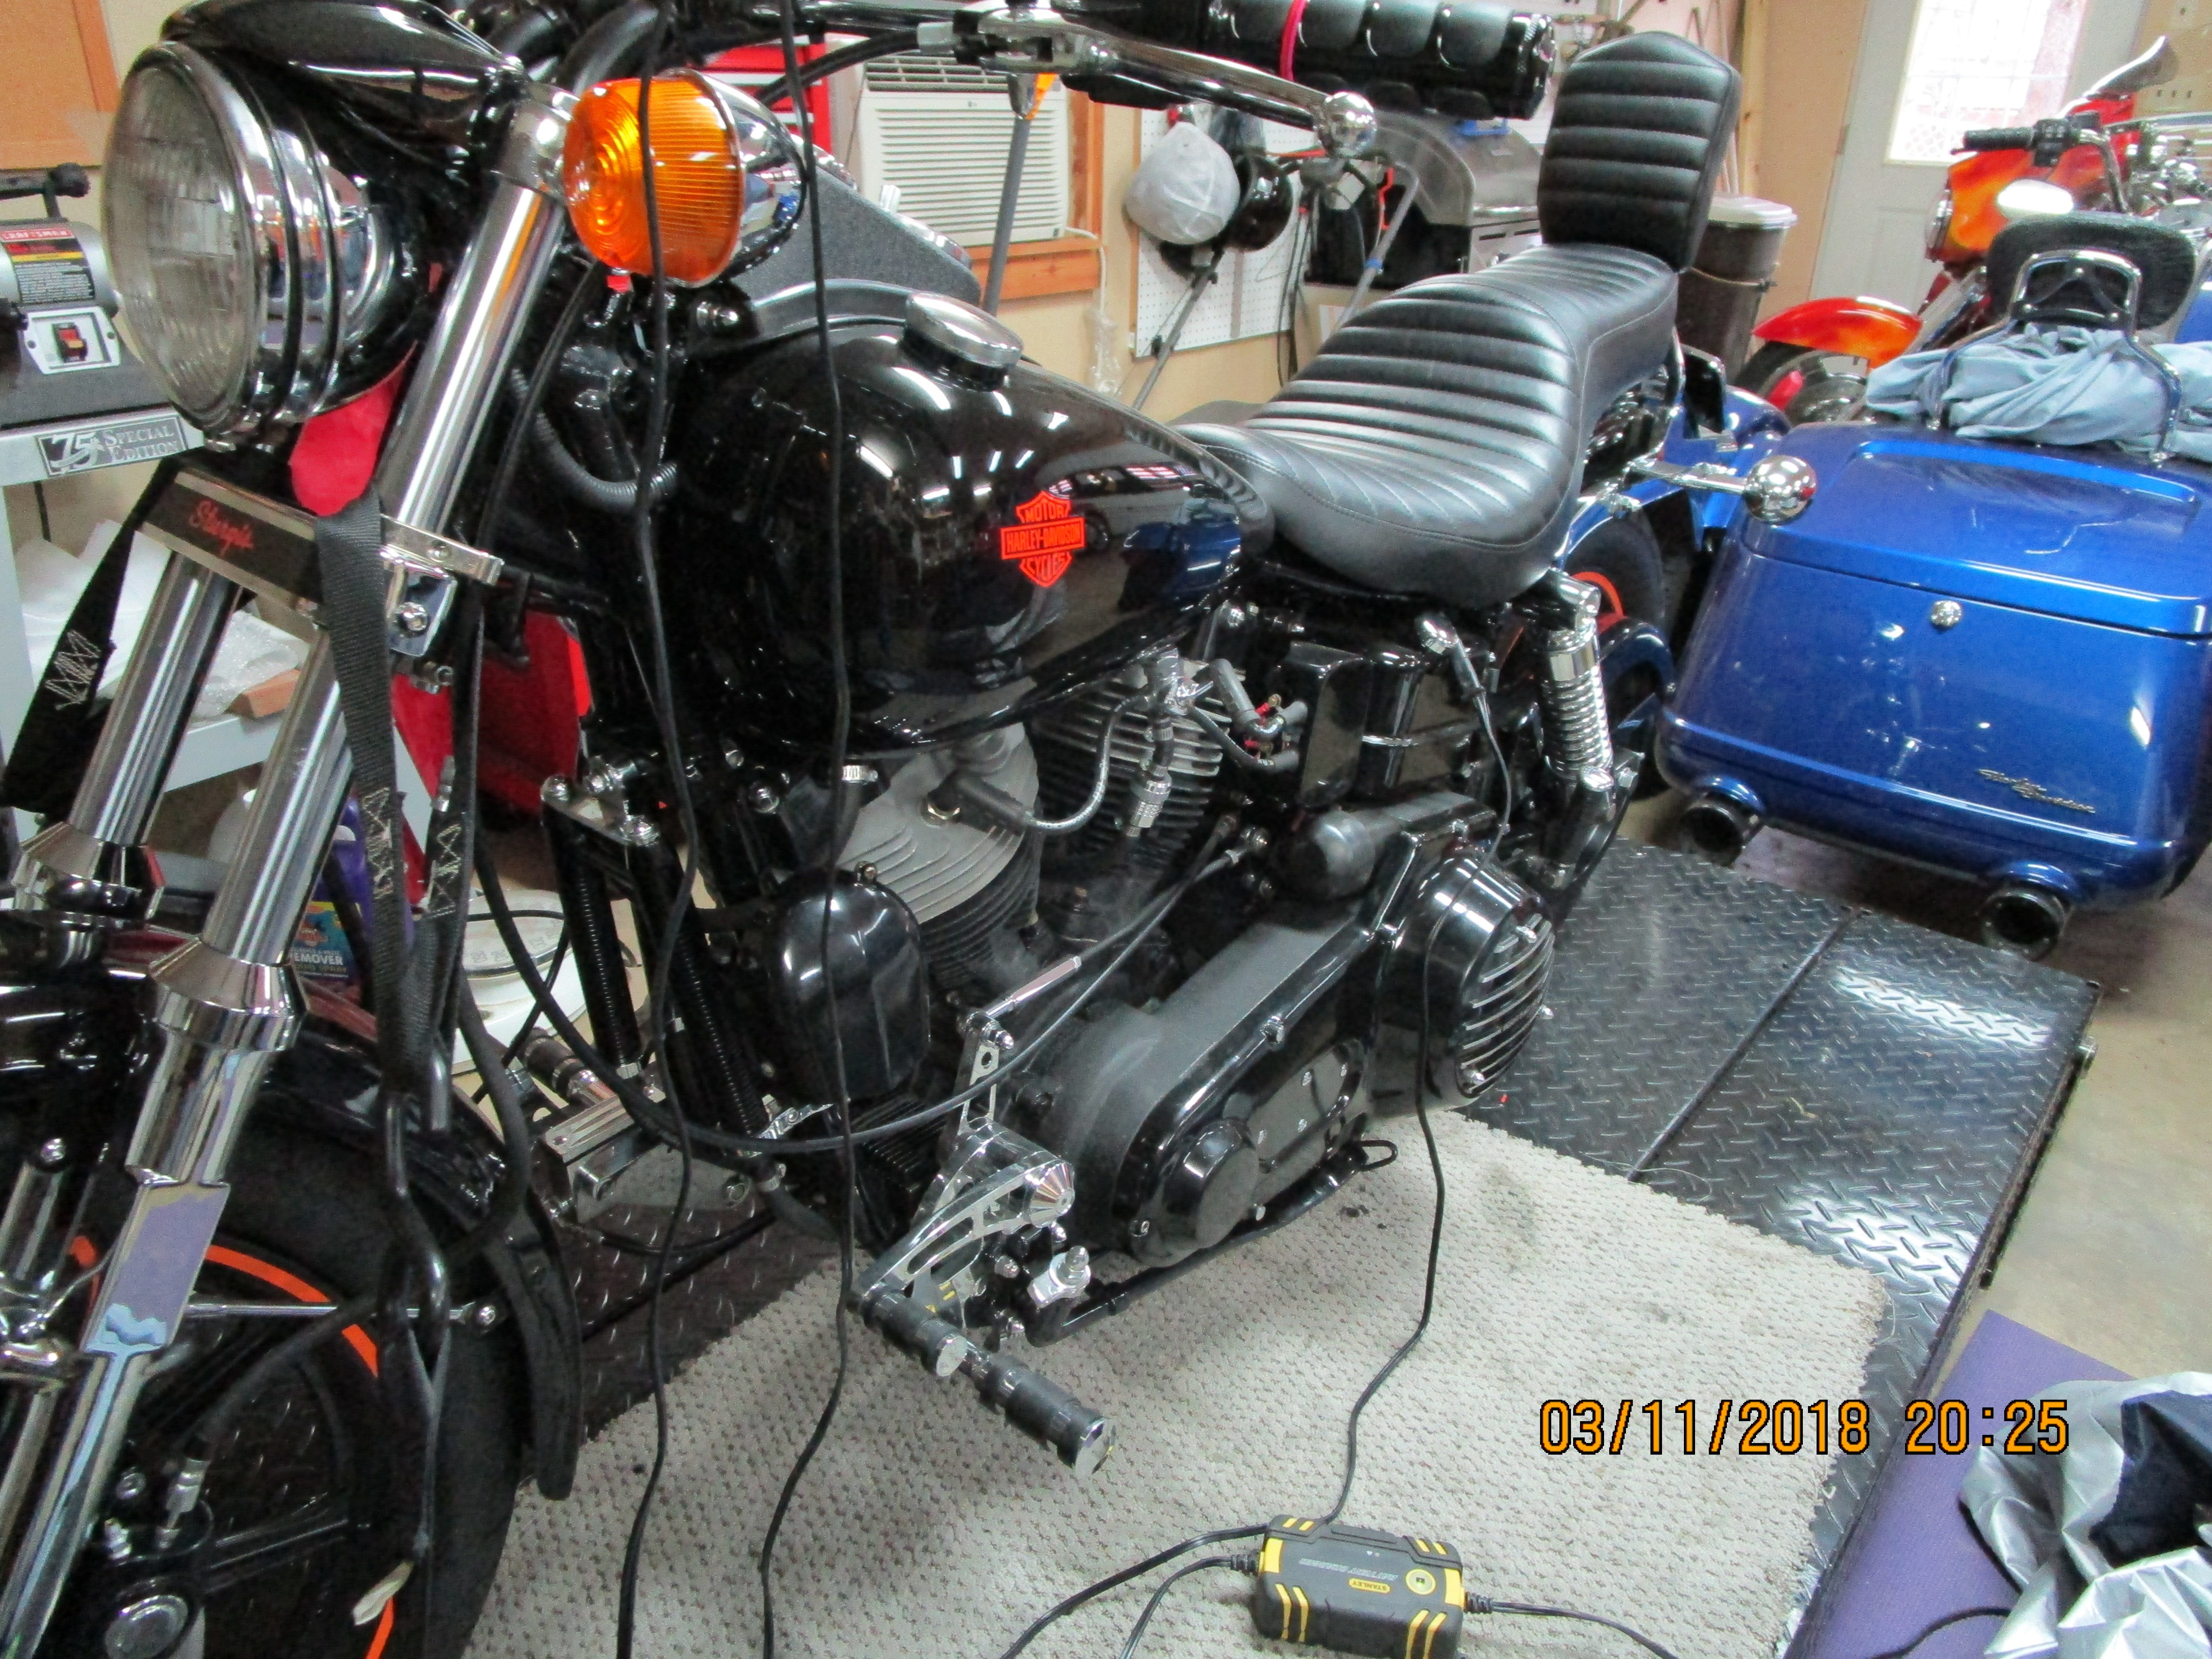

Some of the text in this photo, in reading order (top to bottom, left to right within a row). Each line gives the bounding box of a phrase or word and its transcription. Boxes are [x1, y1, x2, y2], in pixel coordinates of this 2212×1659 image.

[52, 432, 97, 468] 75
[1025, 500, 1065, 522] MOTOR
[1352, 1581, 1387, 1591] STANLEY
